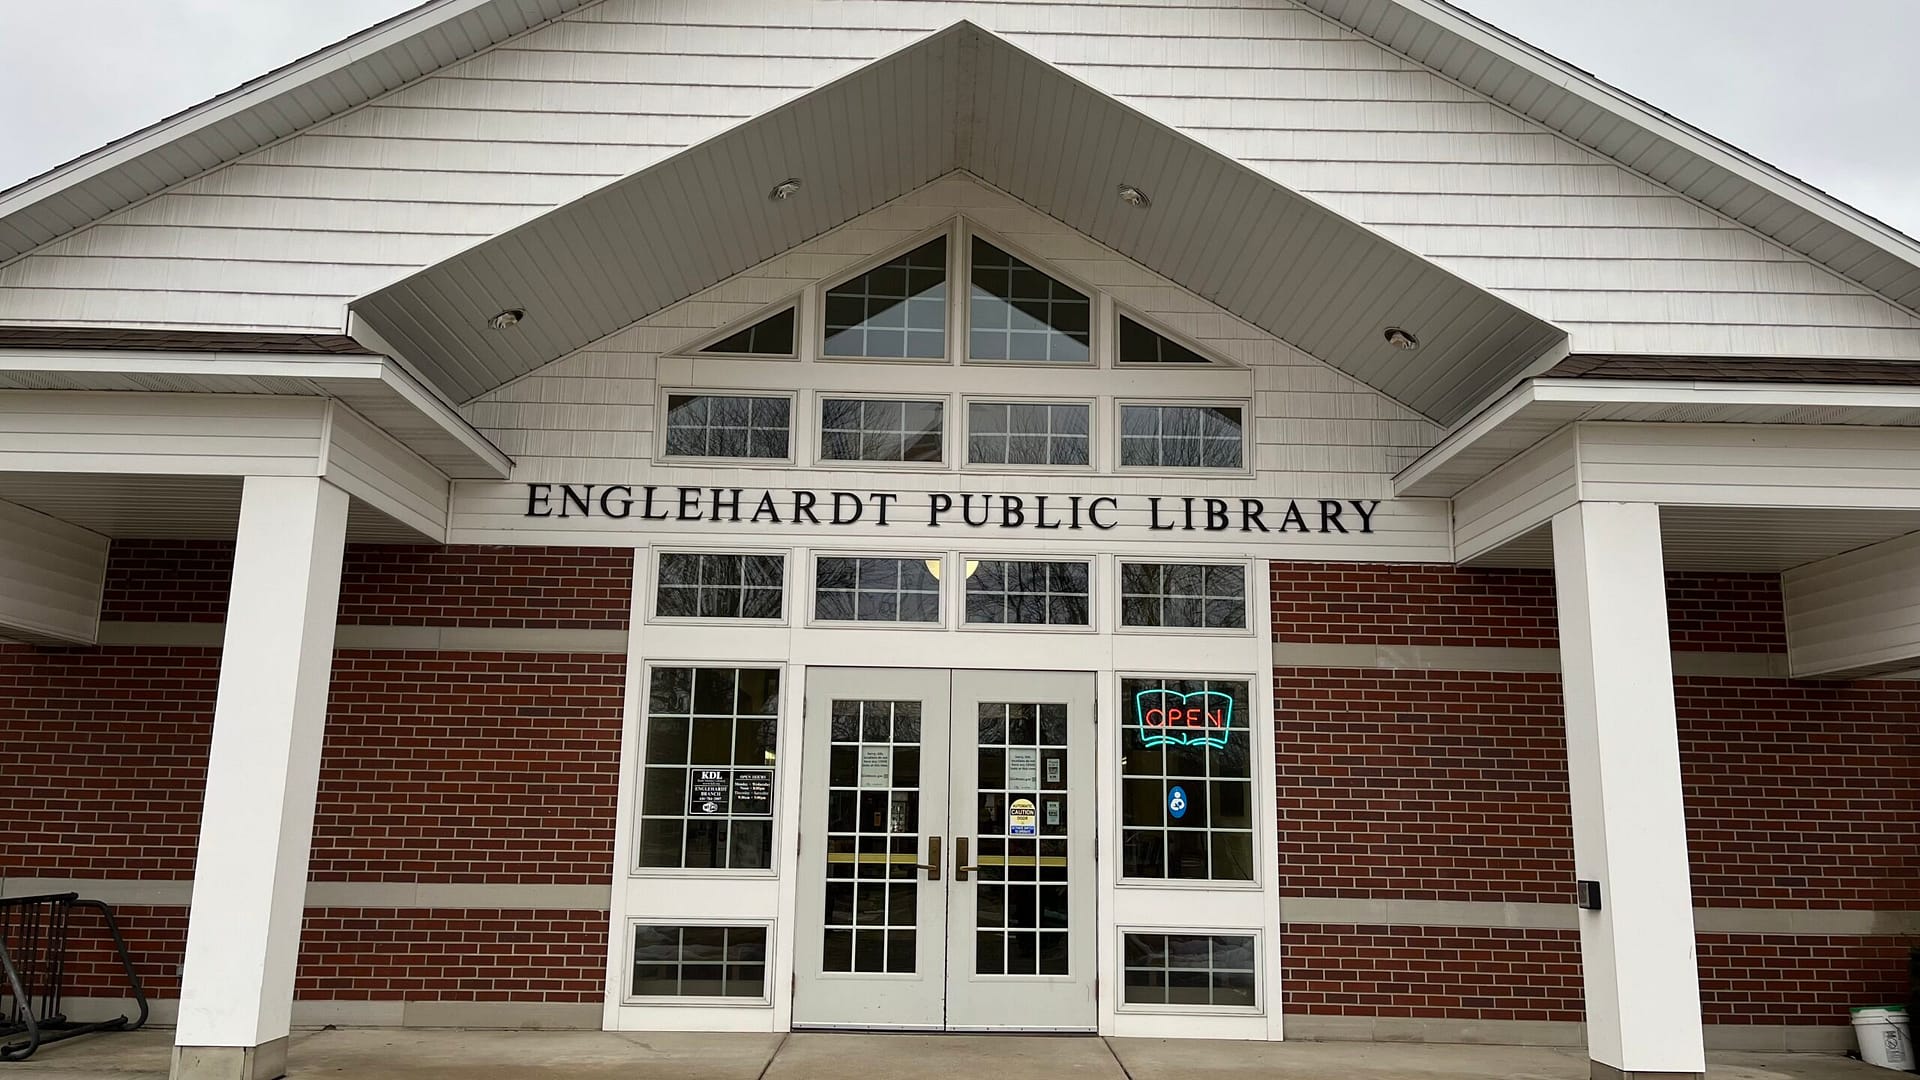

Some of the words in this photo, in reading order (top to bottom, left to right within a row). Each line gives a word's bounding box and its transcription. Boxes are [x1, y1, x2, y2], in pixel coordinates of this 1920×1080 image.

[524, 483, 898, 526] ENGLEHARDT
[927, 493, 1118, 530] PUBLIC
[1148, 497, 1381, 534] LIBRARY
[1145, 708, 1223, 729] OPEN
[701, 771, 723, 780] KDL
